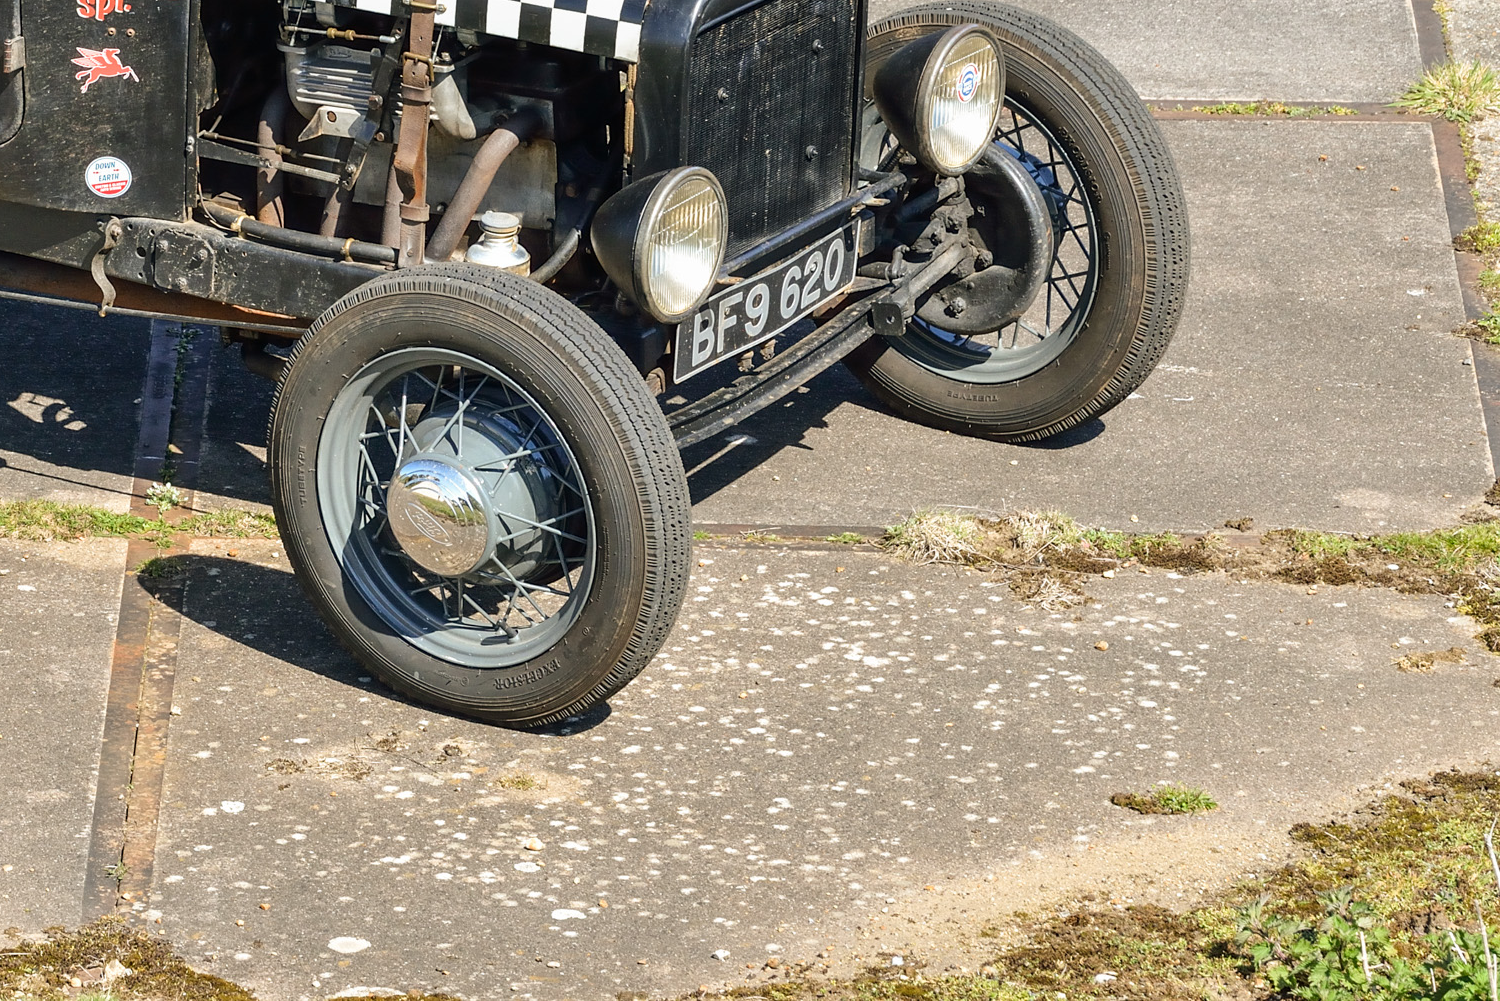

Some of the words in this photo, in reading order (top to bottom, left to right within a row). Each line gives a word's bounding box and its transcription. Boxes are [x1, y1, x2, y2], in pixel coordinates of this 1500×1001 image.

[95, 161, 116, 170] DOWN
[98, 173, 120, 182] EARTH
[691, 282, 770, 368] BF9
[779, 237, 845, 320] 620
[947, 390, 998, 402] TUBETYPE
[297, 445, 308, 505] TUBETYPE
[494, 657, 560, 691] EXCELSIOR
